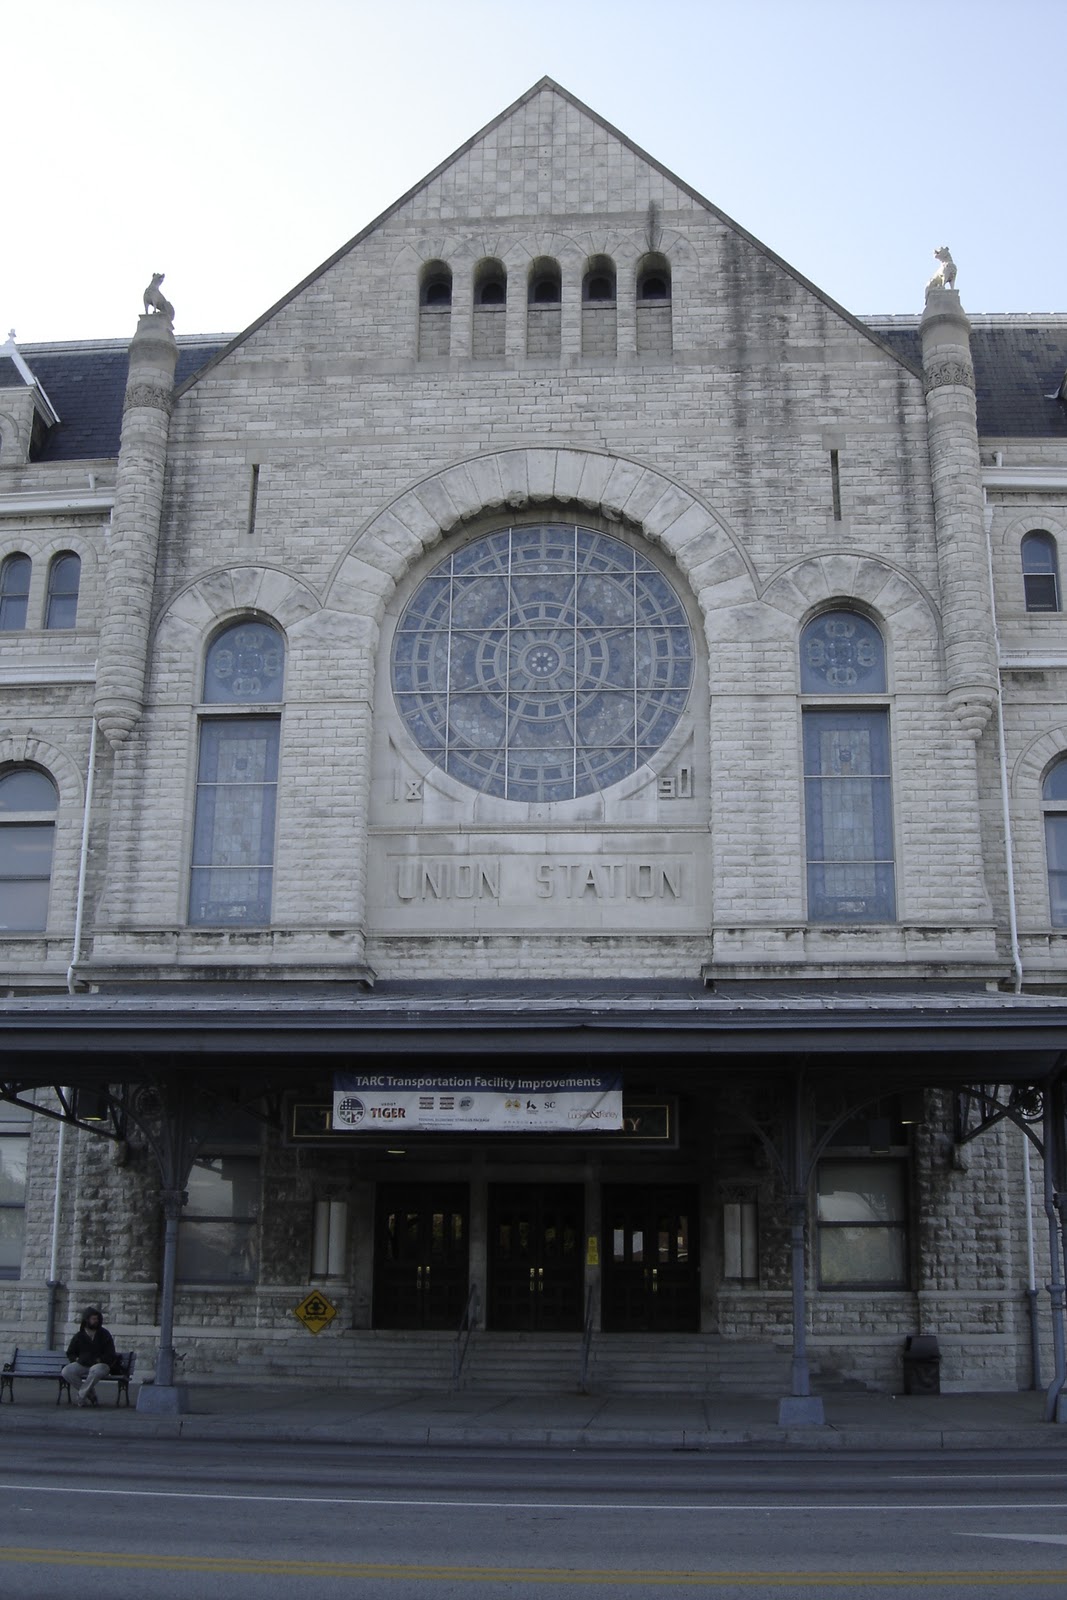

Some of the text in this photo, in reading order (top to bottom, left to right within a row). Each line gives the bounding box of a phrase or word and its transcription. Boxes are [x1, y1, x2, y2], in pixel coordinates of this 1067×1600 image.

[394, 768, 422, 800] 18
[397, 862, 681, 900] UNION STATION
[355, 1076, 602, 1090] TARC Transportation Facility Improvements
[370, 1107, 406, 1118] TIGER
